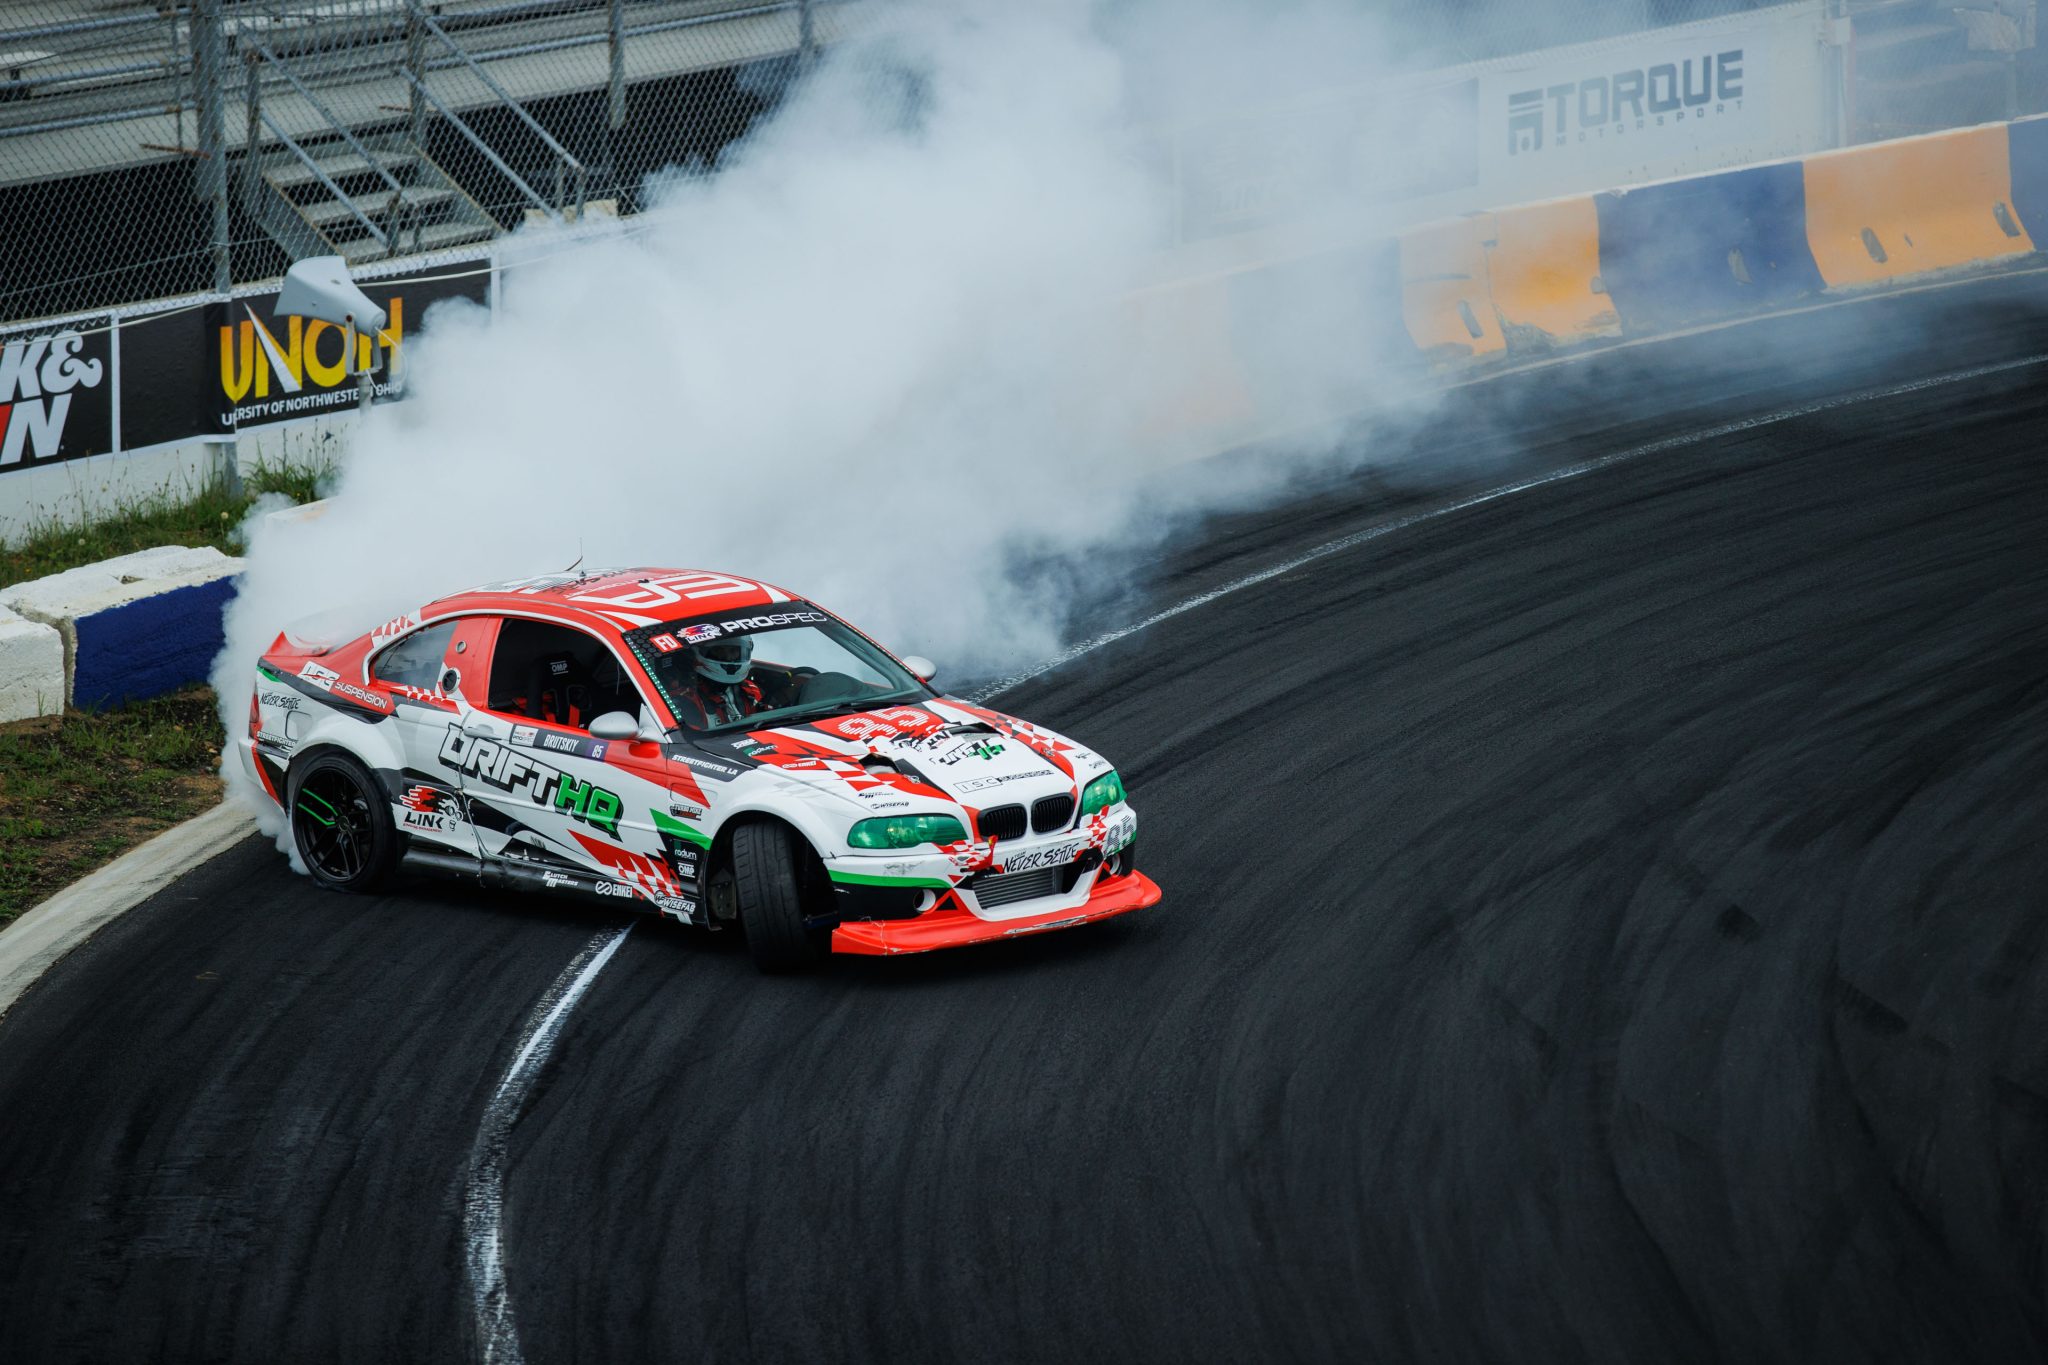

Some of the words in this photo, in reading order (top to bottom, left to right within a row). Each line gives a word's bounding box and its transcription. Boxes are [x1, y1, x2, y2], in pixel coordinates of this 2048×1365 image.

[1547, 49, 1743, 133] TORQUE
[1556, 100, 1743, 147] MOTORSPORT
[271, 400, 286, 414] OF
[687, 632, 713, 642] LINK
[720, 612, 827, 633] PROSPEC
[551, 662, 568, 673] OMP
[260, 692, 280, 707] NEVER
[335, 681, 388, 709] SUSPENSION
[543, 734, 579, 752] BRUTSKIY
[591, 744, 604, 758] 85
[671, 754, 727, 773] STREETFIGHTER
[727, 768, 738, 776] LA
[404, 811, 444, 830] LINK
[674, 848, 697, 860] radium
[1003, 852, 1041, 873] NEVER
[1041, 842, 1080, 866] SETTLE
[542, 870, 568, 880] CLUTCH
[678, 864, 695, 876] OMP
[546, 878, 579, 888] MASTERS
[613, 884, 632, 898] ENKEI
[664, 897, 696, 914] WISEFAB
